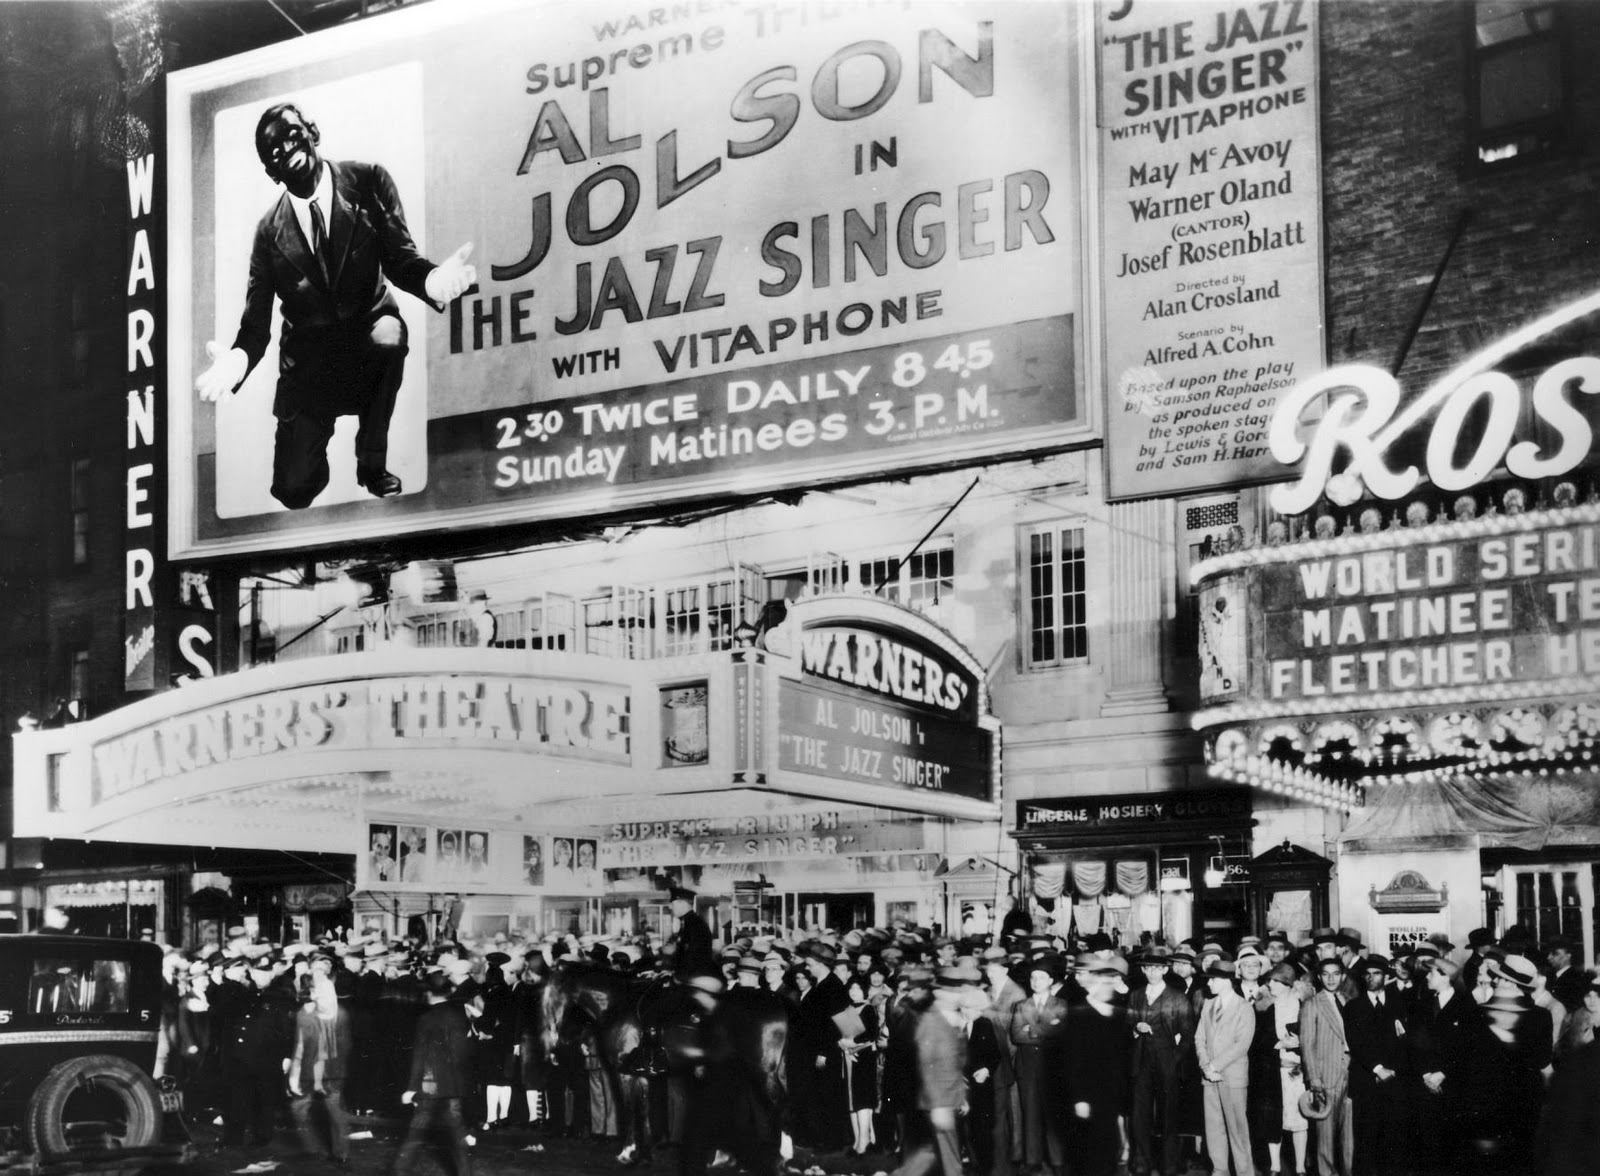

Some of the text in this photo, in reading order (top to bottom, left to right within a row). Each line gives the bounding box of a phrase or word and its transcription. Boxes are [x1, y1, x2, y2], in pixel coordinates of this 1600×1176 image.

[1205, 0, 1308, 52] JAZZ
[526, 26, 725, 95] Supreme
[516, 87, 642, 176] AL
[1110, 87, 1306, 143] WITH VITAPHONE
[491, 20, 994, 281] JOLSON
[855, 136, 897, 175] IN
[1128, 162, 1179, 189] May
[1128, 170, 1292, 223] Warner Oland
[1171, 210, 1250, 242] (CANTOR)
[449, 169, 1056, 354] THE JAZZ SINGER
[1117, 221, 1306, 277] Josef Rosenblatt
[1142, 280, 1280, 321] Alan Crosland
[1176, 272, 1245, 293] Directed by
[552, 289, 943, 379] WITH VITAPHONE
[1178, 324, 1244, 341] Scenario by
[1143, 346, 1198, 366] Alfred
[1179, 374, 1217, 390] upon
[1223, 365, 1248, 381] the
[1256, 361, 1295, 381] play
[573, 394, 698, 436] TWICE
[727, 365, 871, 413] DAILY
[1152, 397, 1276, 425] as produced on
[1154, 390, 1210, 407] Samson
[1215, 376, 1297, 399] Raphaelson
[1139, 443, 1156, 457] by
[1165, 438, 1210, 454] Lewis
[1149, 426, 1172, 440] the
[1176, 418, 1229, 437] spoken
[495, 445, 626, 488] Sunday
[650, 413, 848, 467] Matinees
[1136, 458, 1164, 472] and
[1173, 451, 1207, 468] Sam
[1300, 527, 1595, 600] WORLD SERI
[1303, 589, 1510, 648] MATINEE
[1270, 640, 1513, 699] FLETCHER
[366, 682, 632, 755] THEATRE
[816, 698, 838, 729] AL
[850, 706, 911, 746] JOLSON
[840, 748, 882, 779] JAZZ
[612, 812, 839, 841] SUPREME TRIUMPH
[1026, 808, 1088, 824] LINGERIE
[1100, 803, 1163, 820] HOSIERY
[673, 841, 727, 862] JAZZ
[1389, 933, 1428, 942] BASE
[140, 1009, 150, 1022] 5
